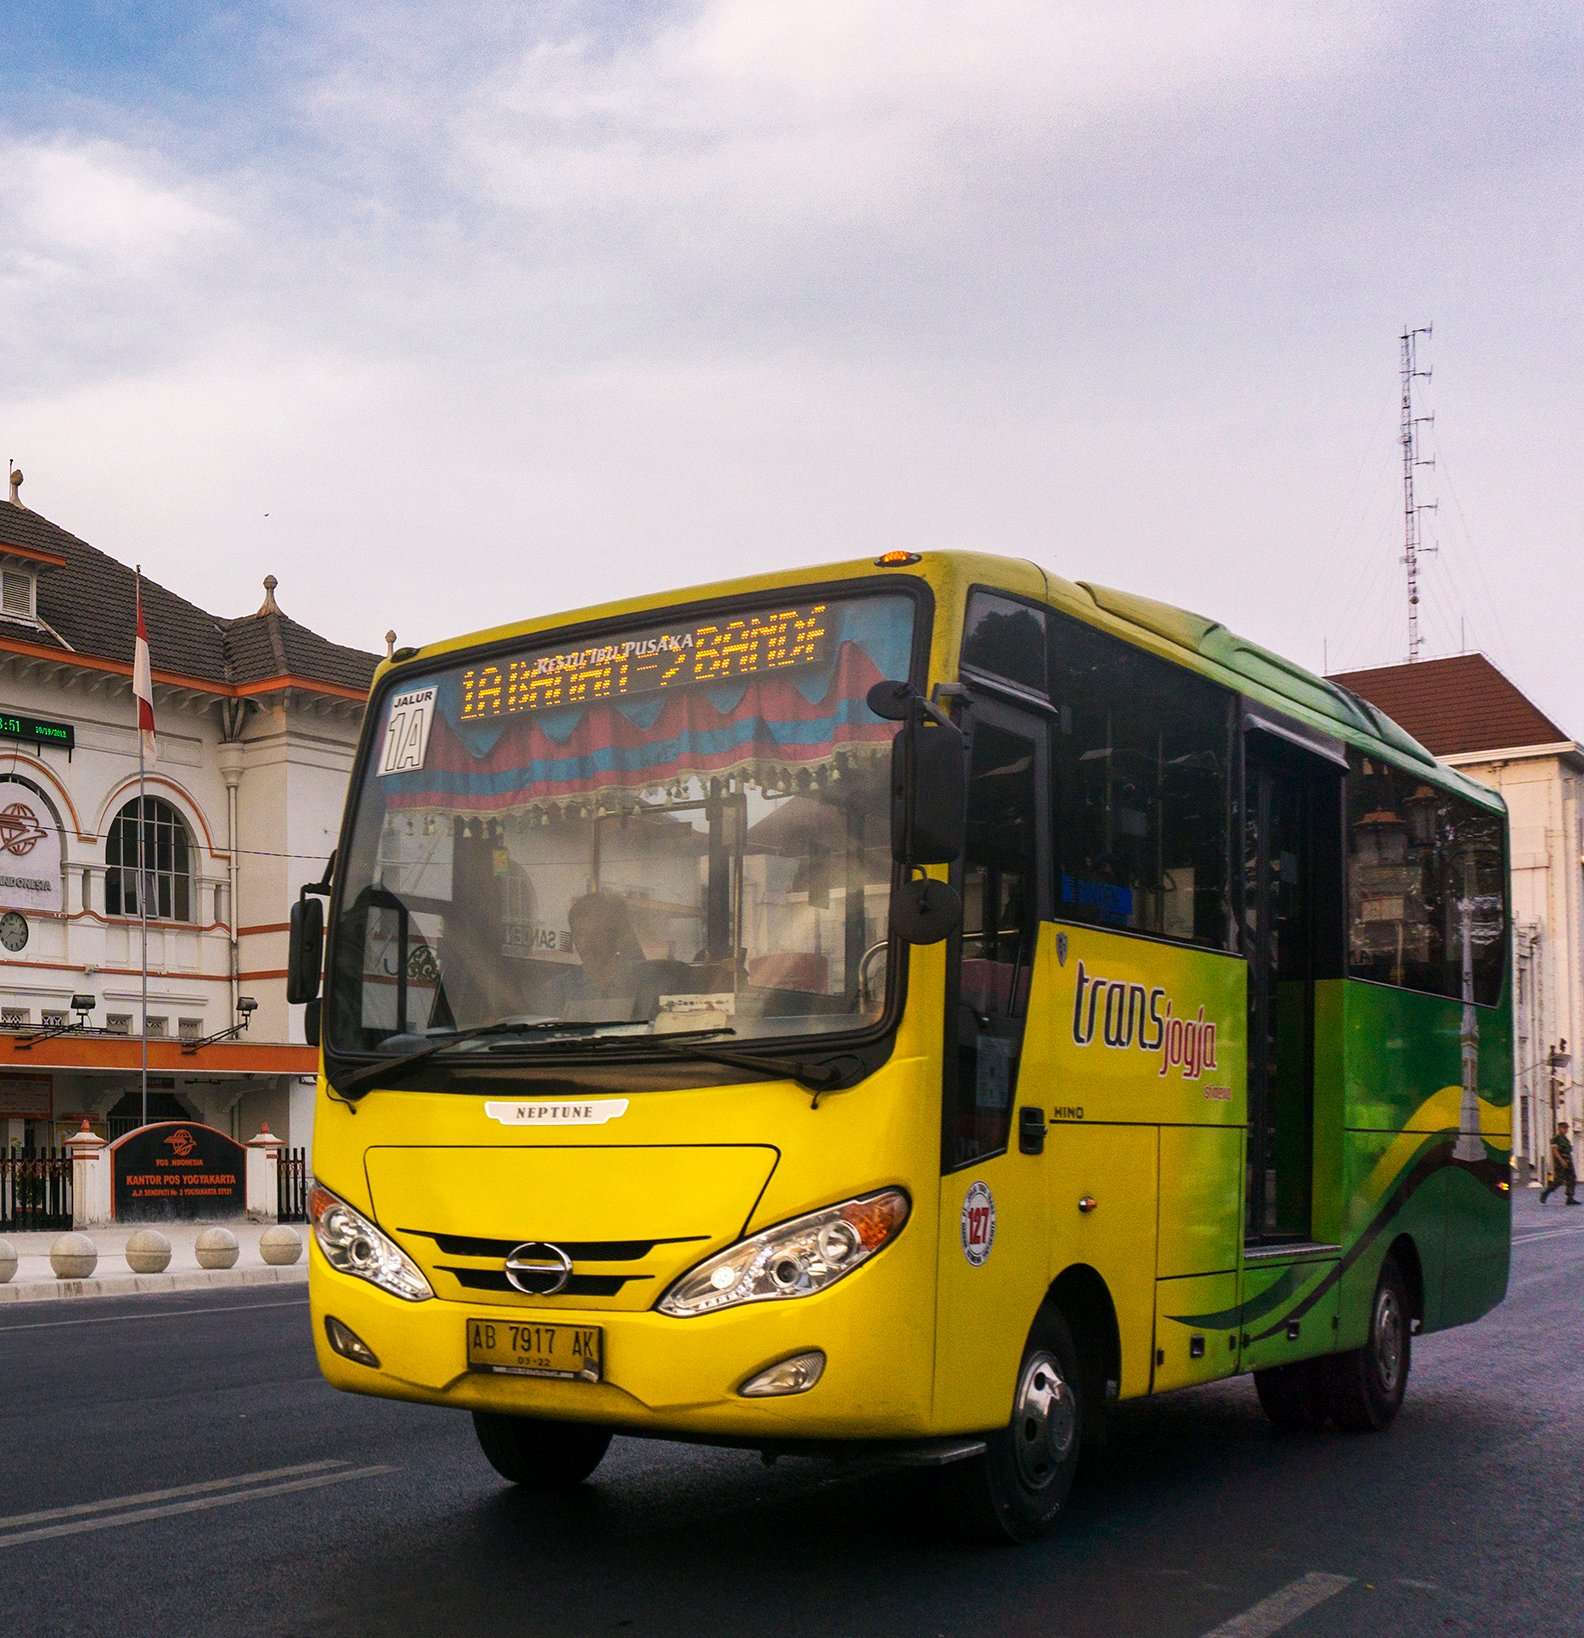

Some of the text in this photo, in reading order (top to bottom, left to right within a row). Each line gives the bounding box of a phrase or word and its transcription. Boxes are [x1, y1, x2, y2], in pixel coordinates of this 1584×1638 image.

[623, 633, 694, 658] PUSAKA
[394, 690, 433, 708] JALUR
[385, 708, 424, 772] 1A
[516, 1106, 593, 1119] NEPTUNE
[1054, 1106, 1084, 1119] HINO
[126, 1175, 236, 1185] KANTOR POS YOGYAKARTA
[968, 1207, 990, 1245] 127
[473, 1324, 594, 1358] AB 7917 AK
